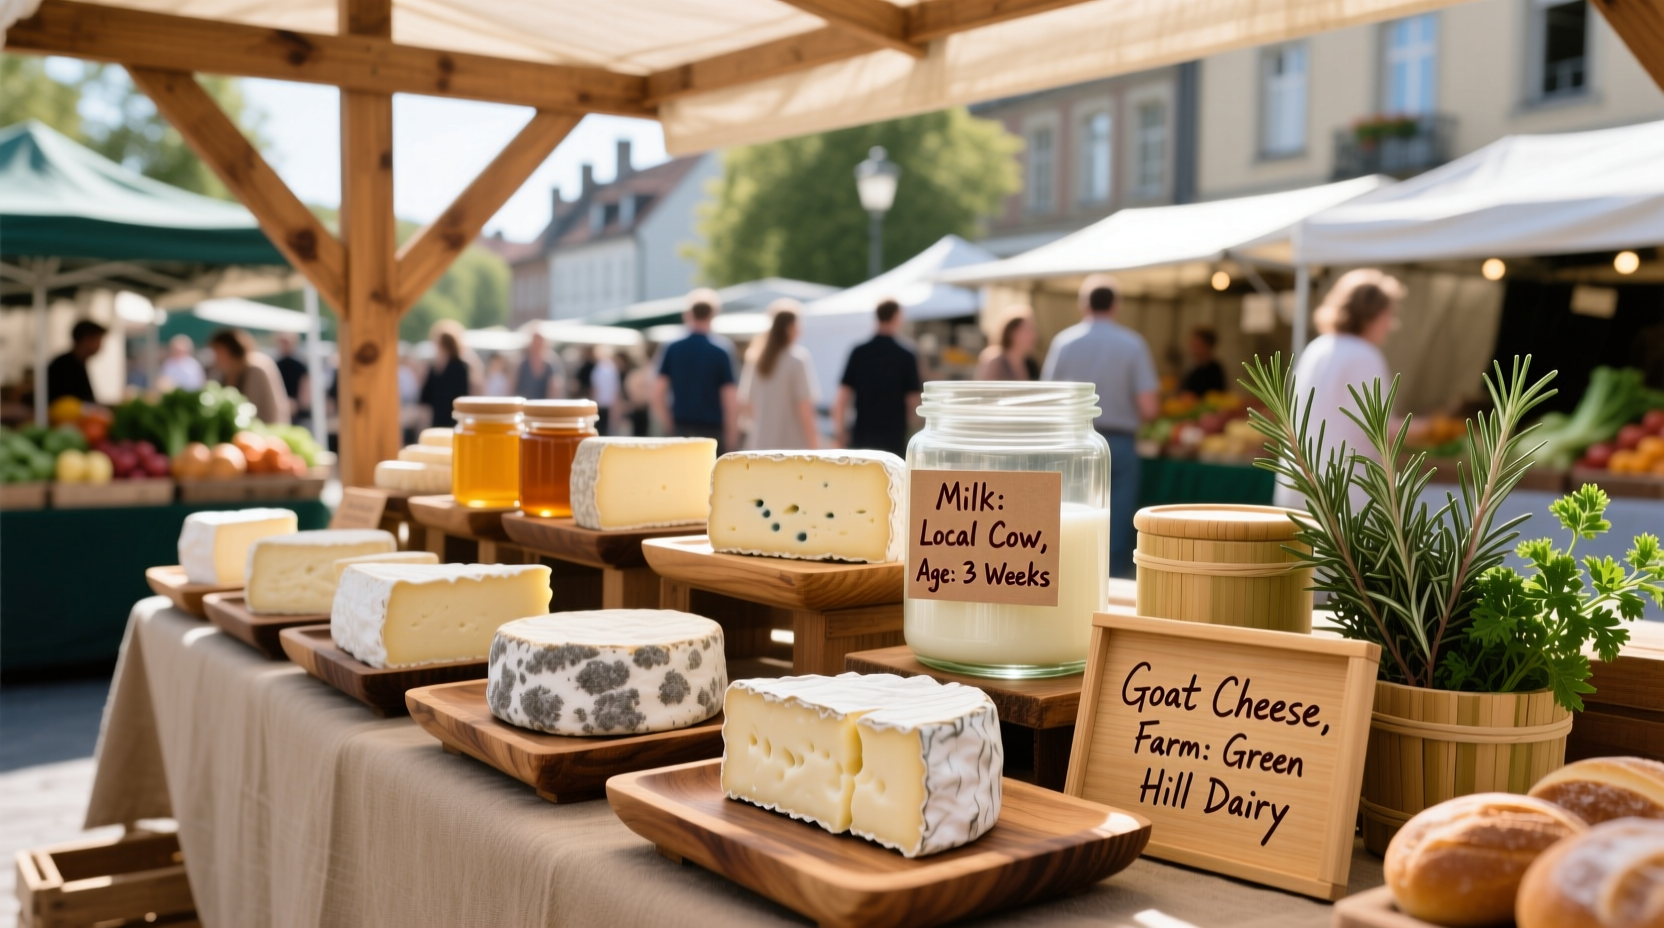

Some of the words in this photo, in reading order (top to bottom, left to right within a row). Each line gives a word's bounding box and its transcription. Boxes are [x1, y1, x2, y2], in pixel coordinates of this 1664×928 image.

[936, 481, 1004, 512] Milk:
[920, 519, 977, 547] Local
[988, 520, 1047, 554] Cow,
[916, 557, 956, 593] Age:
[962, 560, 977, 584] 3
[984, 561, 1050, 588] Weeks
[1121, 661, 1202, 713] Goat
[1212, 675, 1330, 736] Cheese,
[1134, 720, 1211, 761] Farm:
[1222, 732, 1304, 778] Green
[1139, 767, 1194, 810] Hill
[1203, 776, 1290, 847] Dairy
